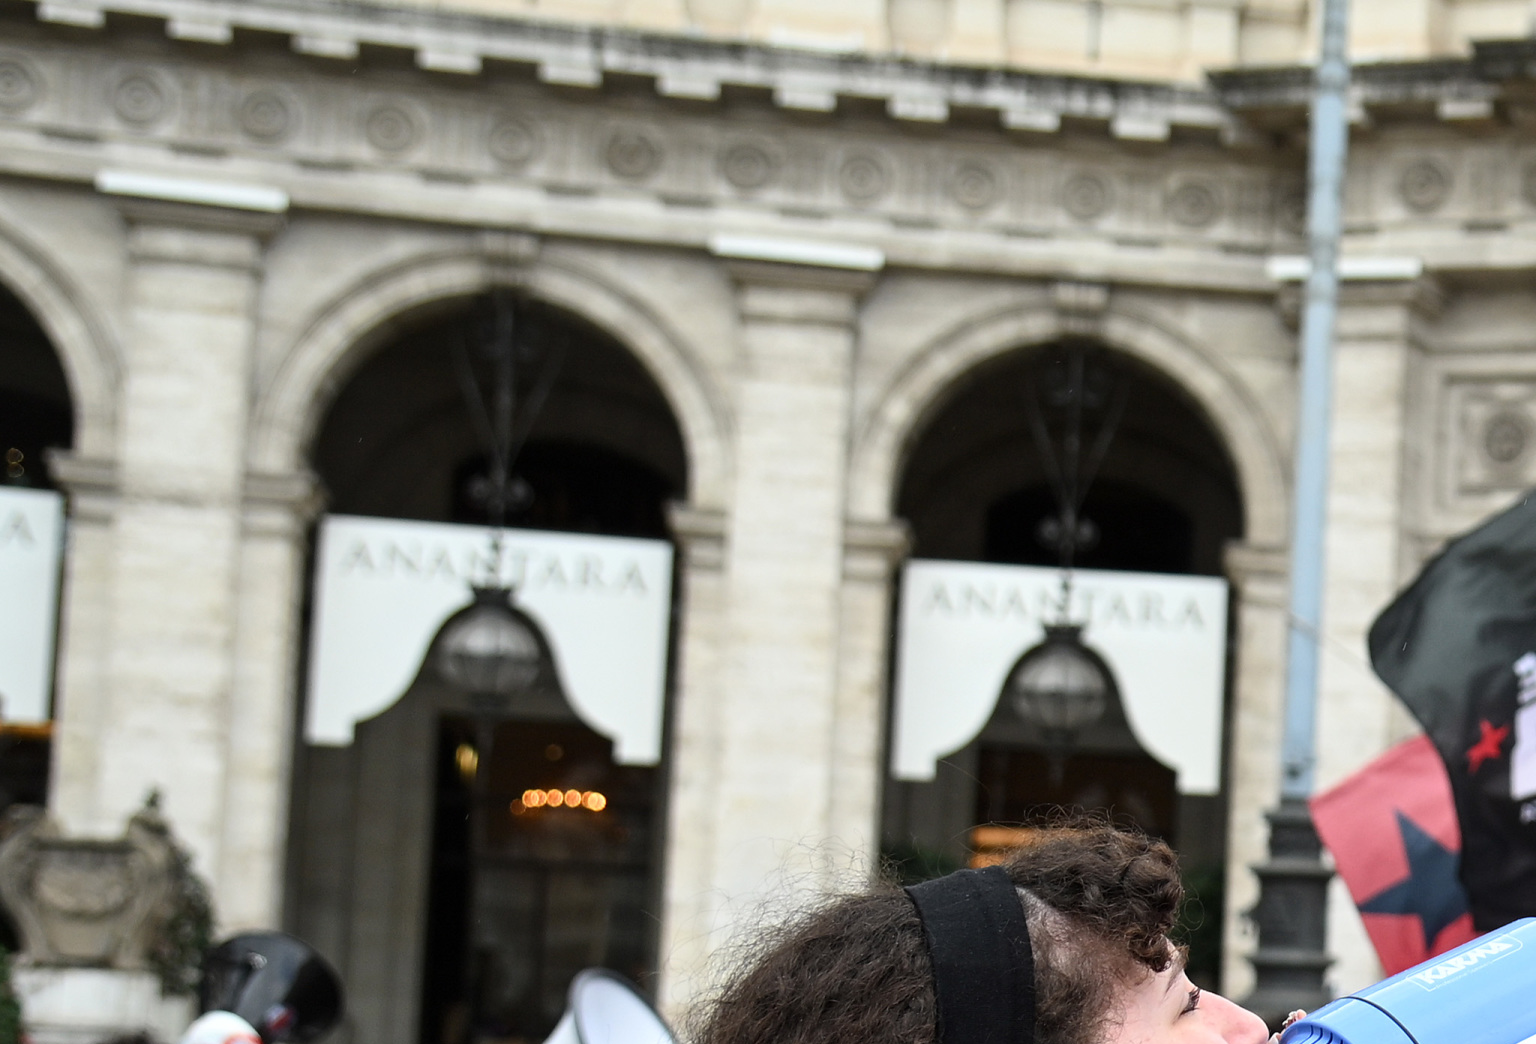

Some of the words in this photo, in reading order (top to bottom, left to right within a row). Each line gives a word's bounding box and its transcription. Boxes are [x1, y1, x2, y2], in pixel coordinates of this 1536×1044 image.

[341, 539, 649, 593] ANANTARA
[925, 579, 1206, 628] ANANTARA
[1412, 938, 1513, 984] KARMA
